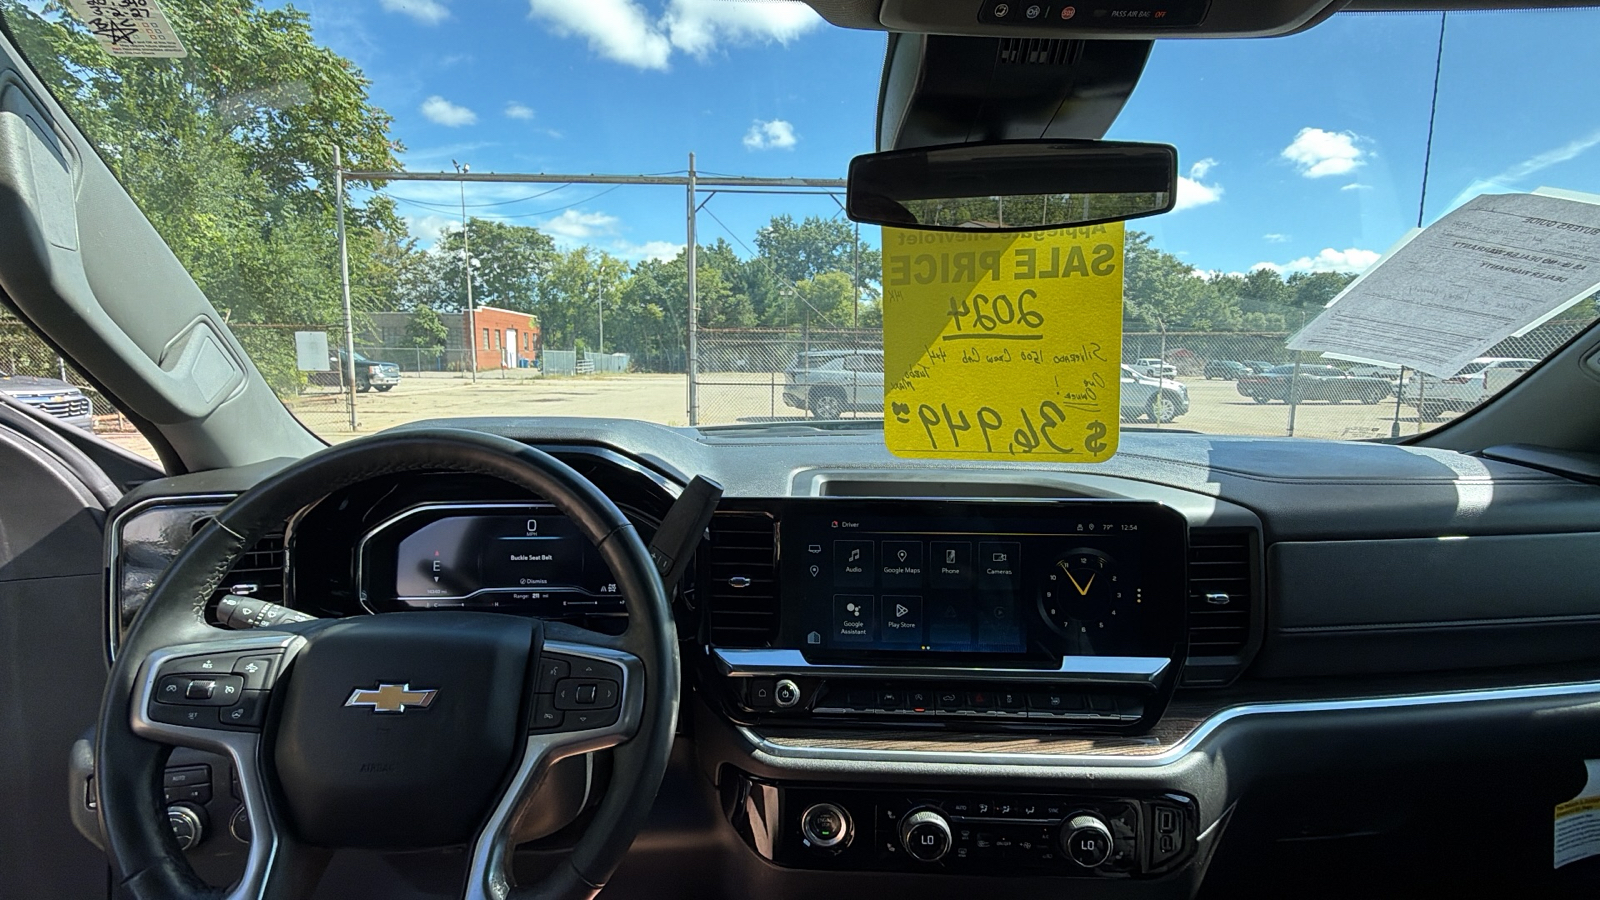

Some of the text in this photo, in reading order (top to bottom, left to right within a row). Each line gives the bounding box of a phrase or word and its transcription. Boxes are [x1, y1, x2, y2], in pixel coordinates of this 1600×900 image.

[1111, 10, 1167, 18] PASS AIR BAG OFF
[842, 521, 860, 529] Driver
[883, 567, 921, 575] Google Maps
[941, 567, 960, 575] Phone
[986, 568, 1012, 576] Cameras
[843, 620, 864, 628] Google
[888, 621, 916, 629] Play Store
[921, 835, 934, 845] LO
[1081, 840, 1095, 851] LO
